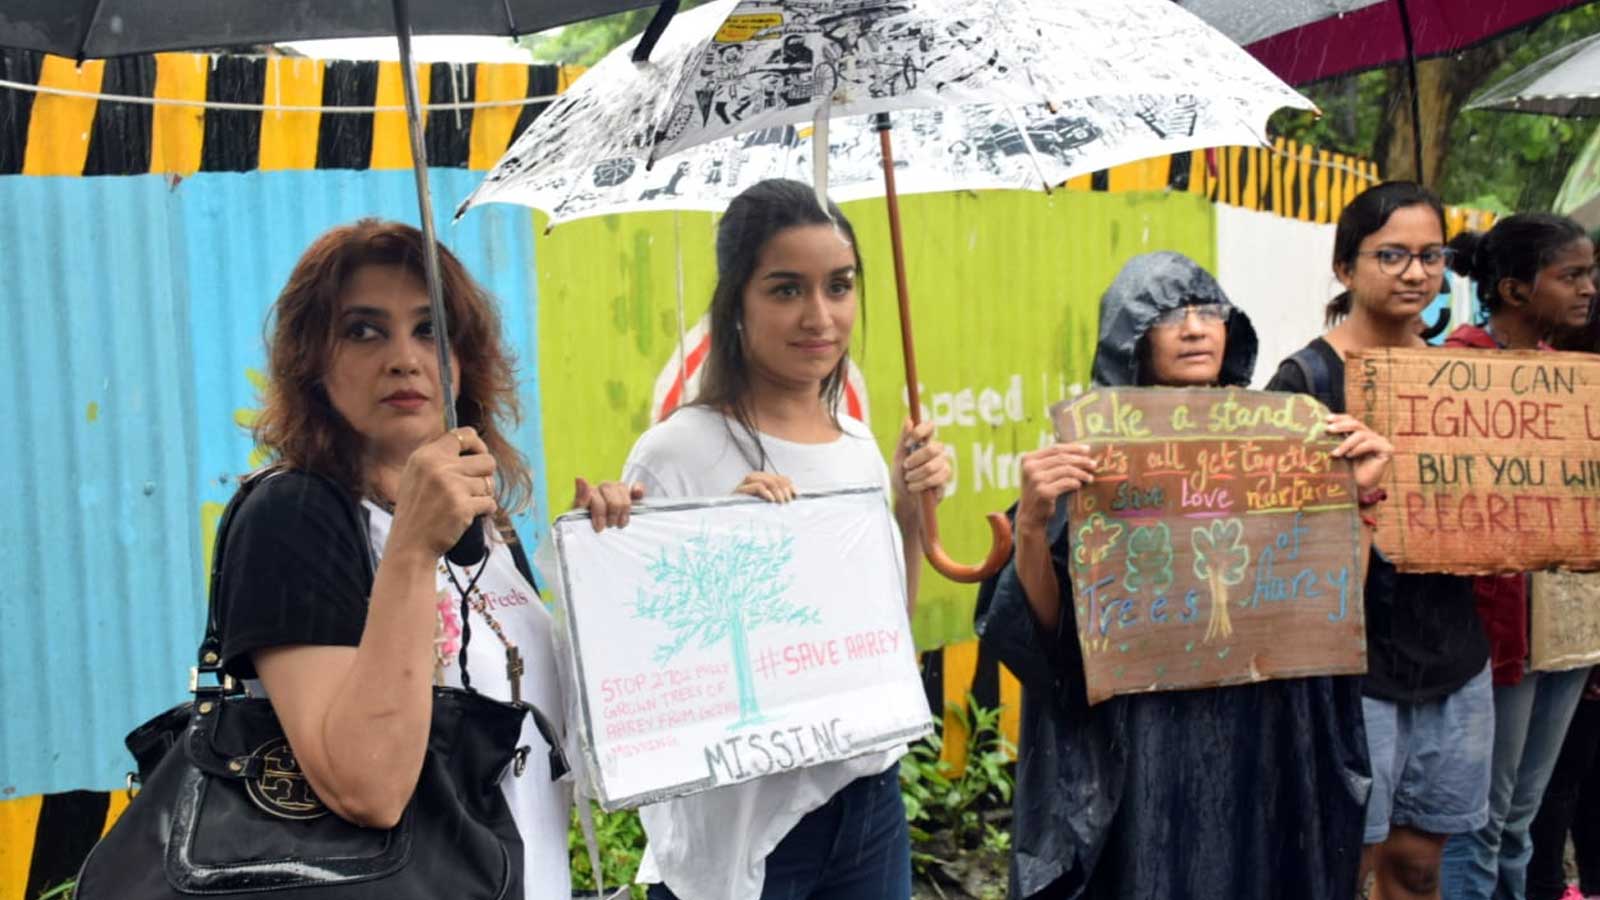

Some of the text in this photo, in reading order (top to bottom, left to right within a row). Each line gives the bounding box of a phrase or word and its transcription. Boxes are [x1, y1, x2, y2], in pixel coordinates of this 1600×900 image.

[1428, 360, 1575, 394] YOU CAN
[1063, 391, 1151, 441] Take
[1171, 404, 1196, 431] a
[1396, 395, 1600, 441] IGNORE U
[1147, 442, 1185, 470] all
[1190, 441, 1237, 491] get
[1241, 441, 1331, 495] together
[1418, 453, 1475, 485] BUT
[1486, 457, 1545, 486] YOU
[1181, 477, 1234, 508] Love
[1246, 477, 1346, 510] nurture
[1406, 493, 1600, 537] REGRET I
[1276, 511, 1311, 560] of
[1081, 574, 1199, 637] Trees
[756, 629, 901, 679] #SAVE AAREY
[601, 672, 647, 703] STOP
[703, 718, 851, 783] MISSING
